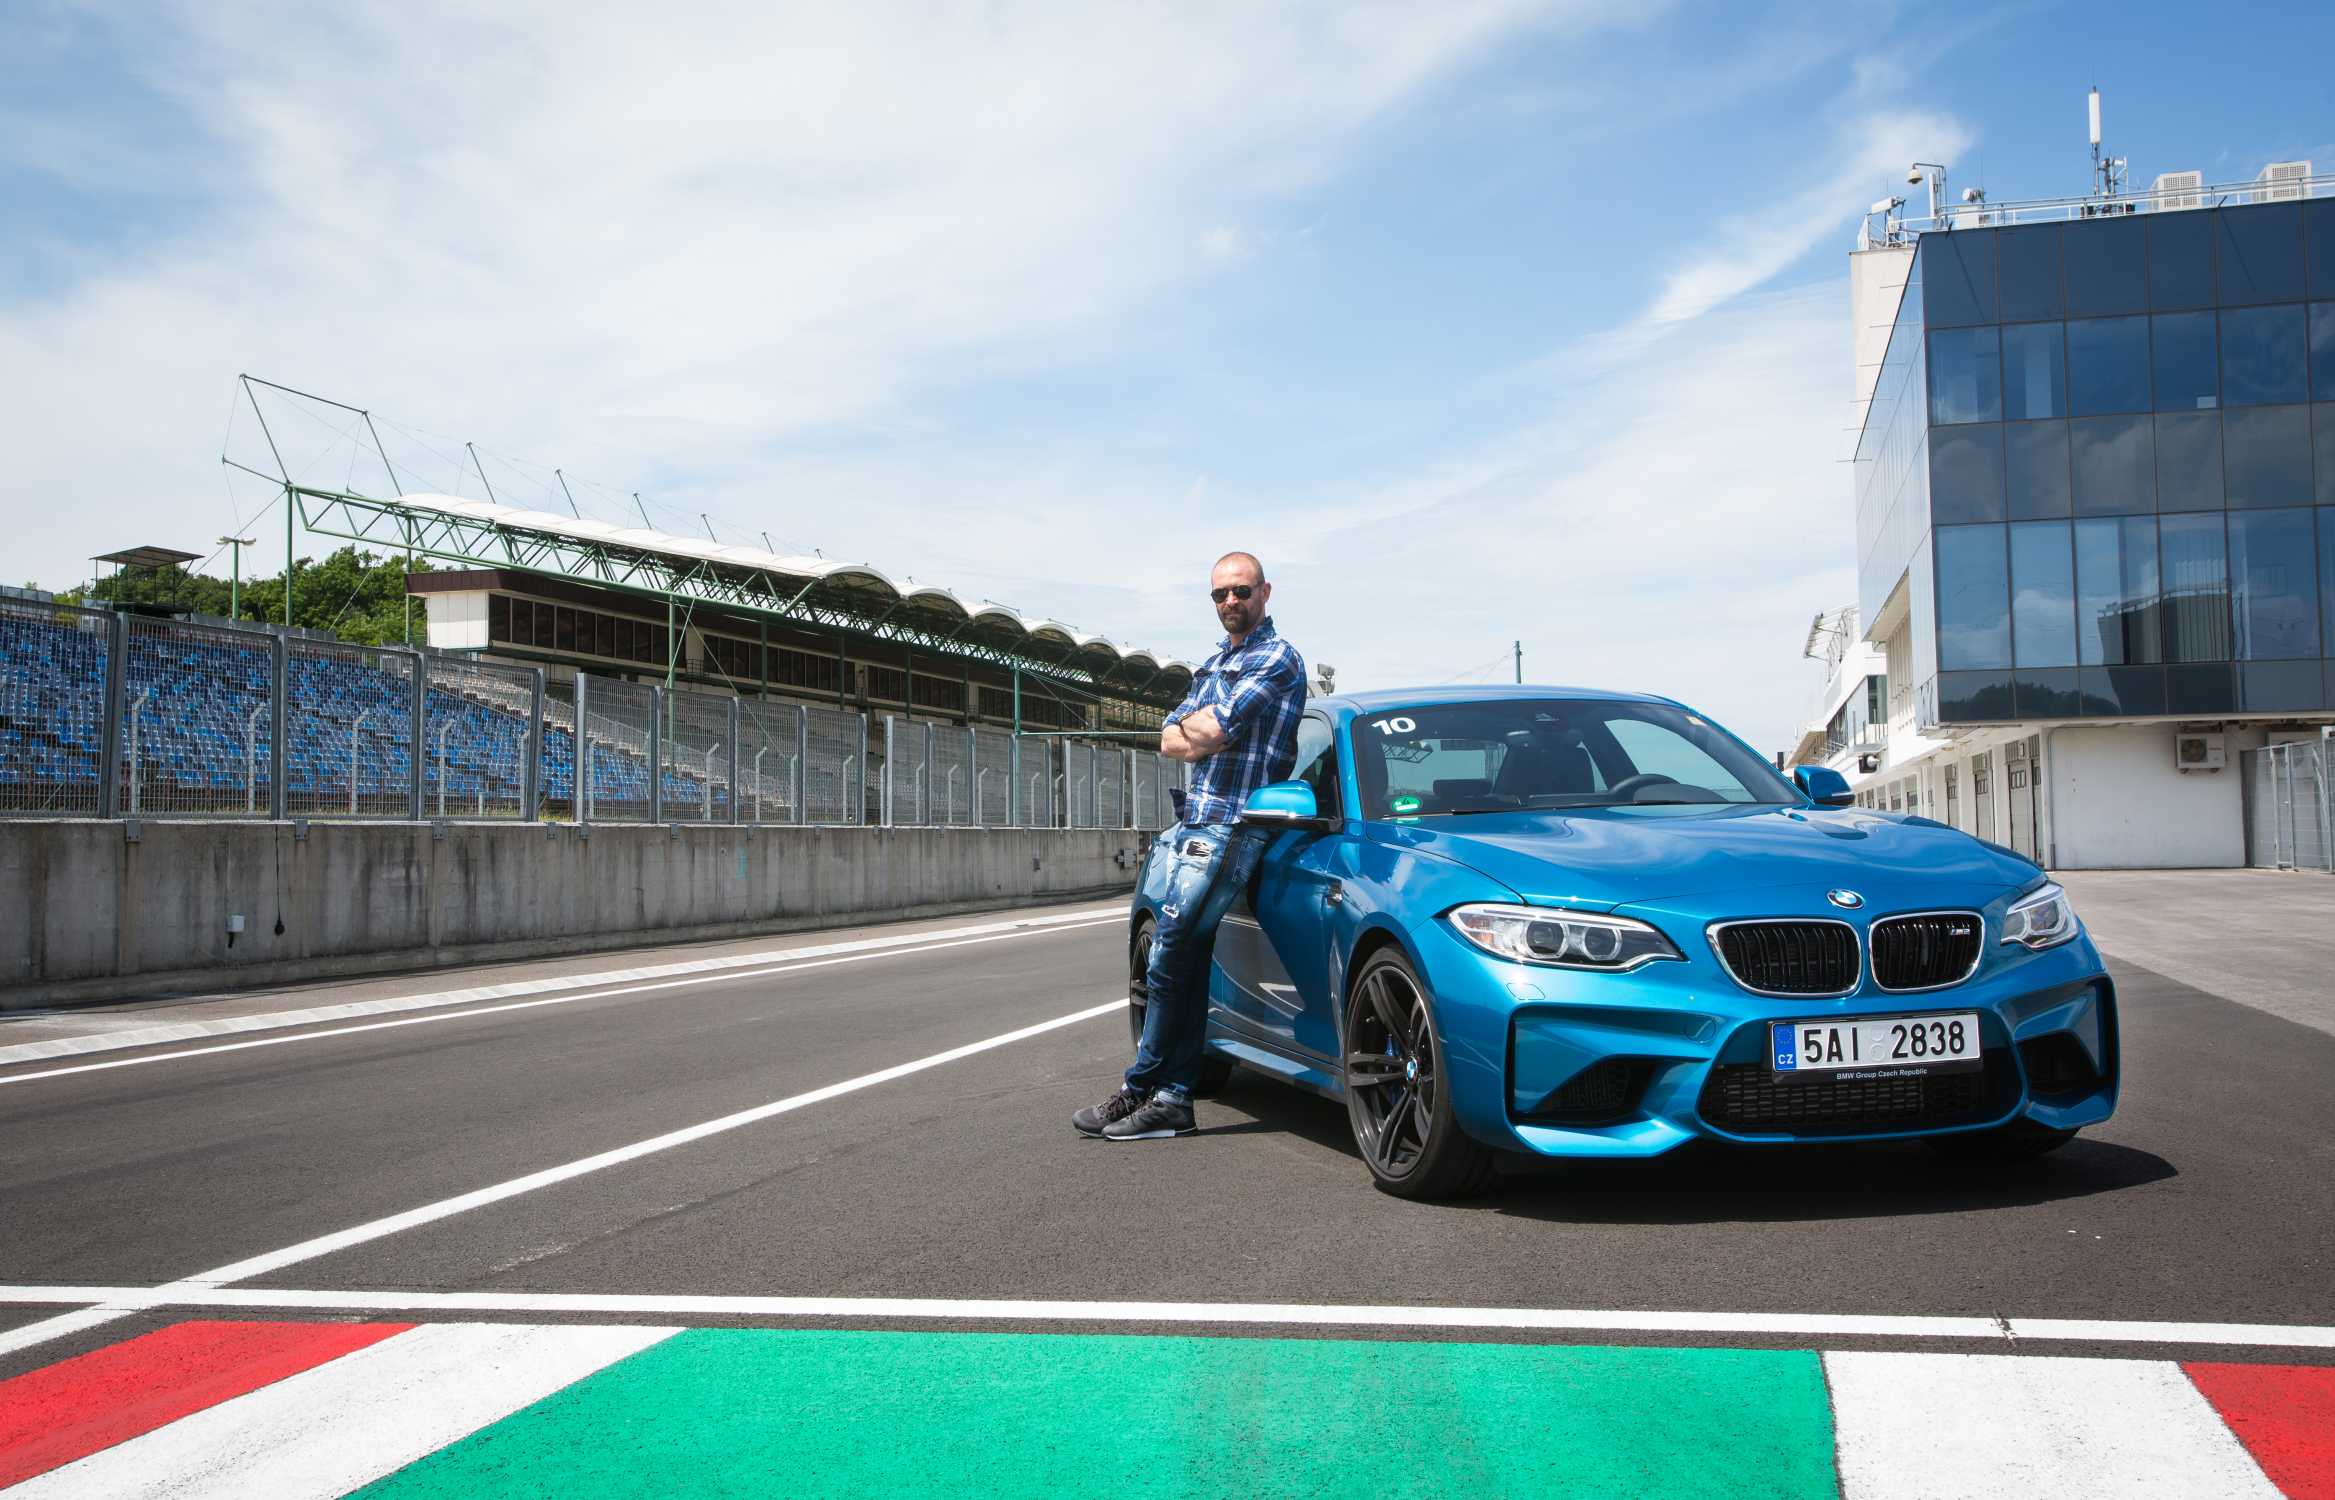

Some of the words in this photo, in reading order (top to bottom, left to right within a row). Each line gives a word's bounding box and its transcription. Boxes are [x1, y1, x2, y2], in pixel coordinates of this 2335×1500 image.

[1371, 717, 1416, 735] 10
[1891, 1020, 1965, 1059] 2838
[1778, 1053, 1793, 1065] CZ
[1836, 1072, 1854, 1080] BMW
[1855, 1071, 1877, 1079] Group
[1878, 1069, 1898, 1077] Czech
[1899, 1067, 1928, 1077] Republic
